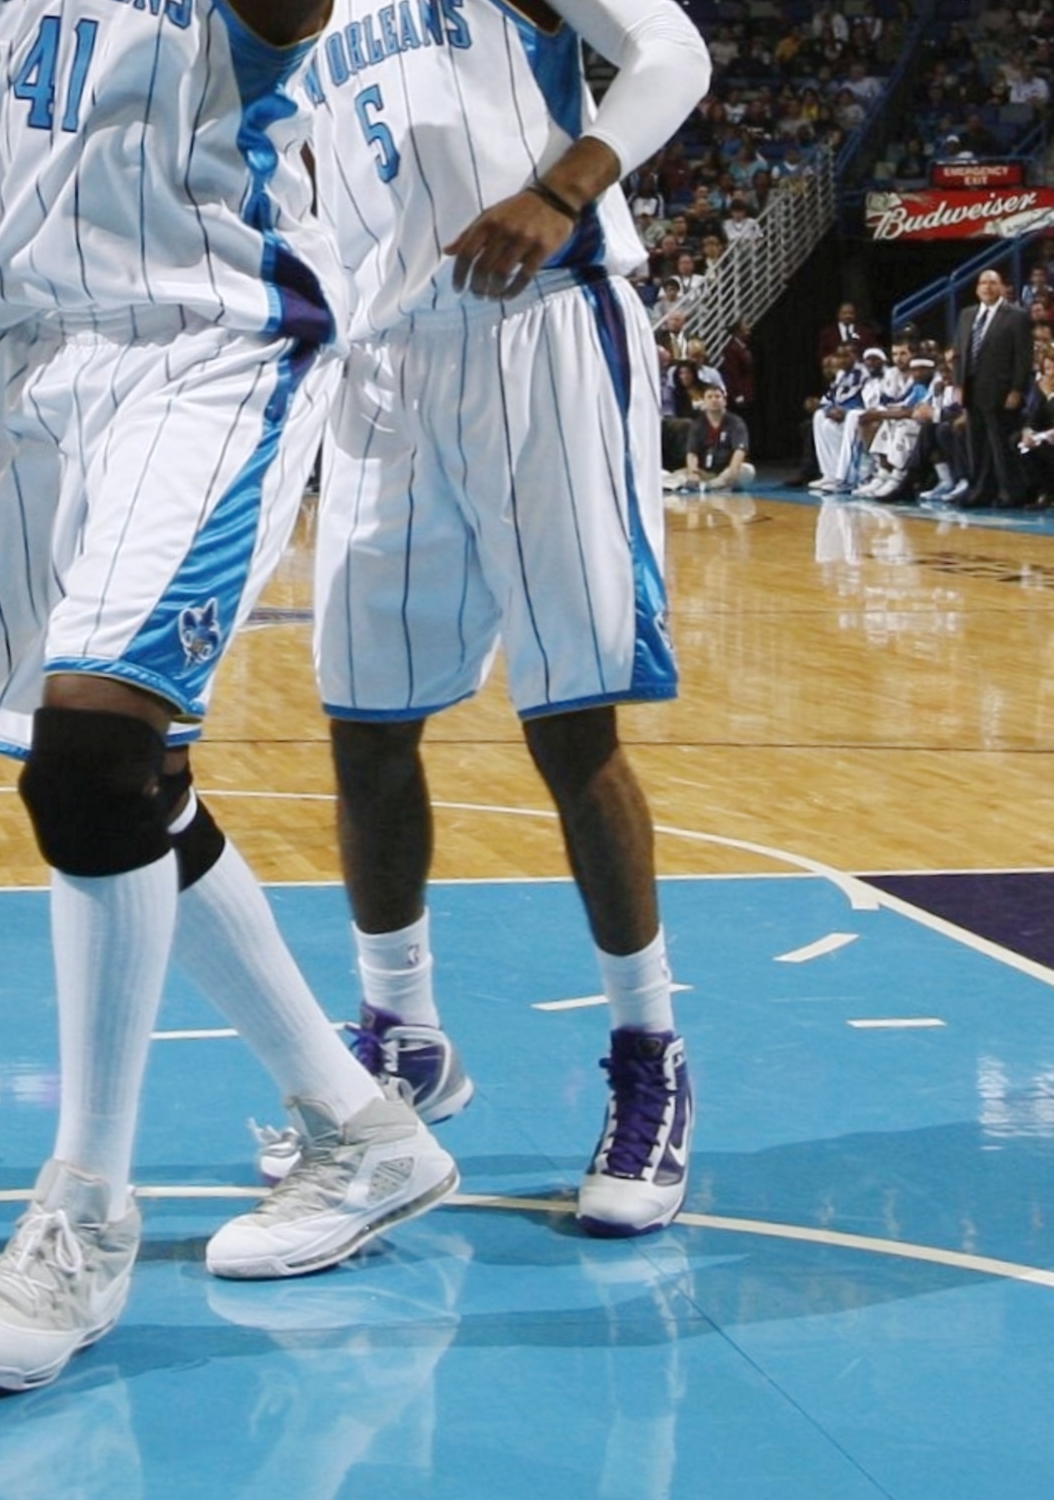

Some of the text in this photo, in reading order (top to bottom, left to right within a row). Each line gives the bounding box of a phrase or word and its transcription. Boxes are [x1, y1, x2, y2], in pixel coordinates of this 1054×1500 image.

[12, 14, 100, 134] 41
[353, 82, 401, 184] 5
[943, 165, 1009, 177] EMERGENCY
[964, 176, 988, 186] EXIT
[872, 192, 1038, 241] Budweiser
